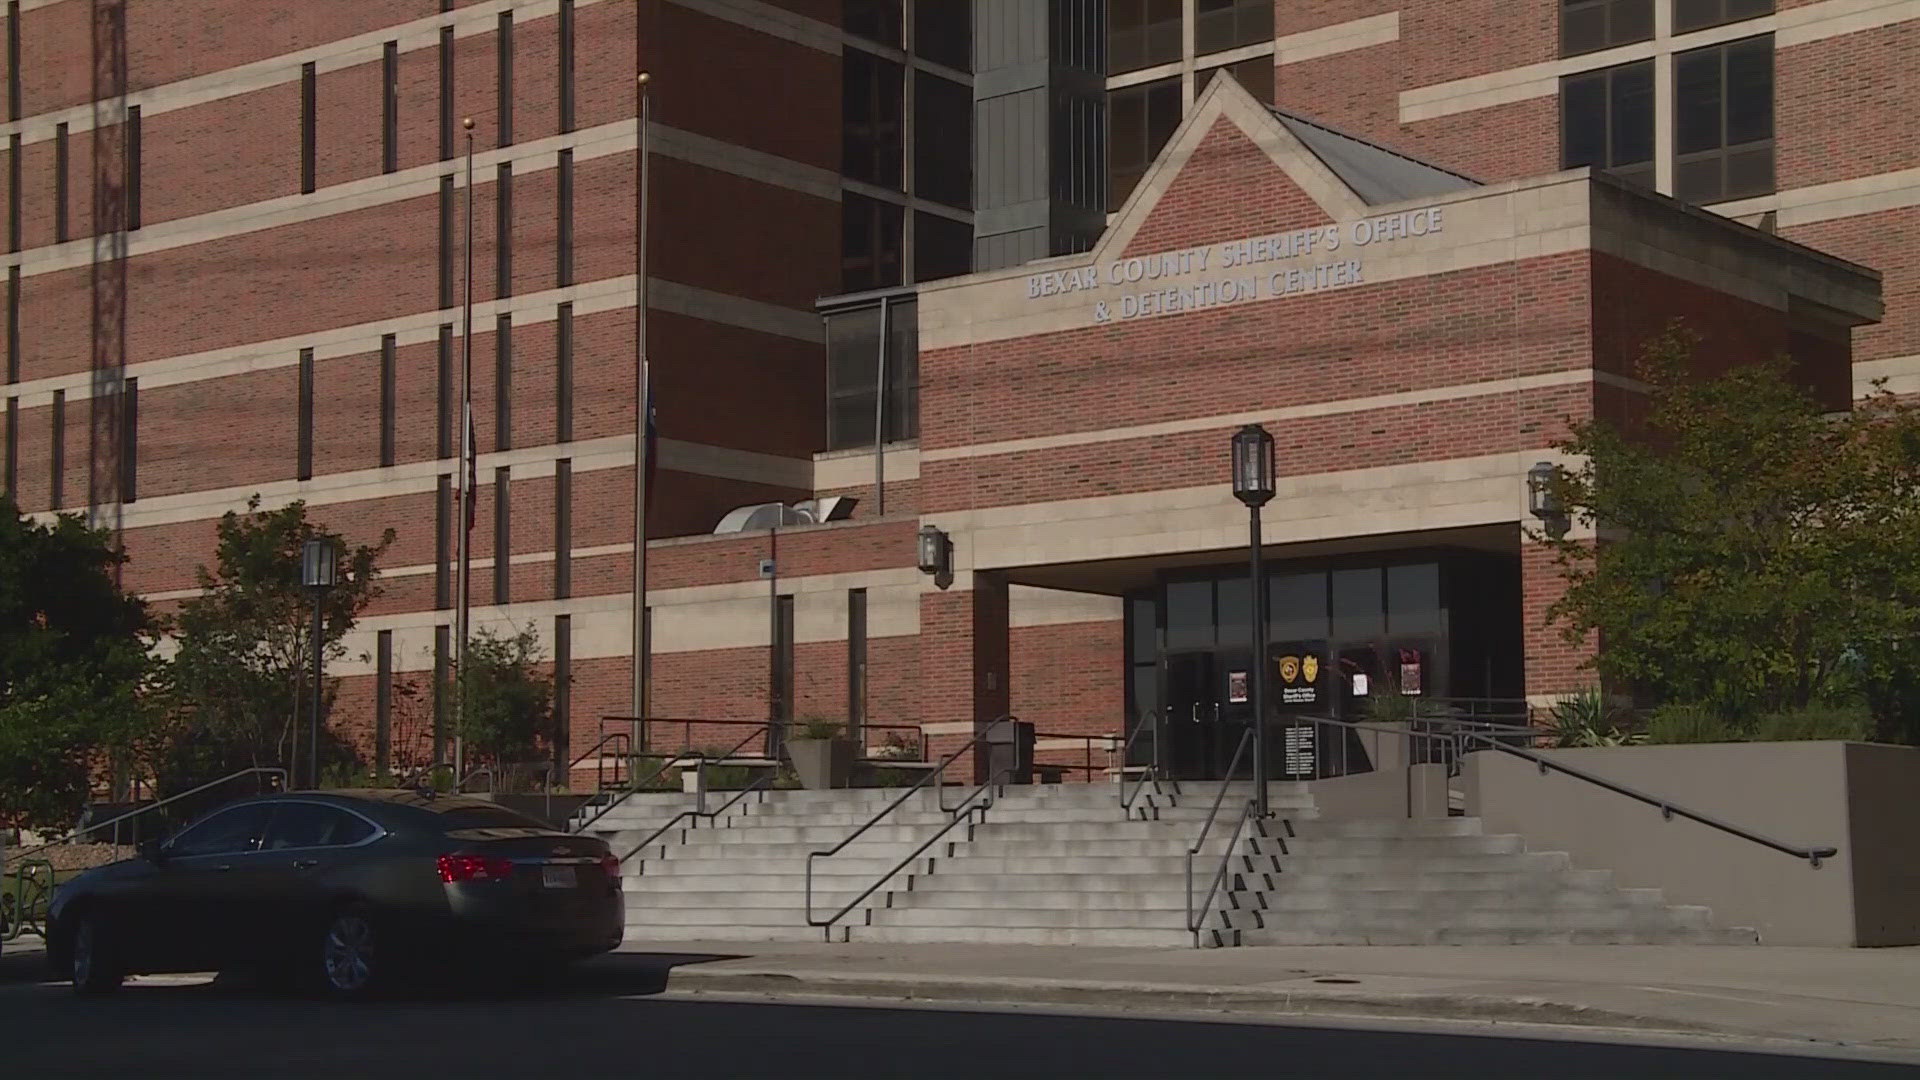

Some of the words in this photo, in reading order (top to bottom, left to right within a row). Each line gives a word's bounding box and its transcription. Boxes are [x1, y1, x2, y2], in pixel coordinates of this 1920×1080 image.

[1028, 268, 1098, 299] BEXAR
[1109, 247, 1211, 286] COUNTY
[1222, 226, 1341, 269] SHERIFF'S
[1351, 207, 1443, 247] OFFICE
[1095, 299, 1112, 323] &
[1121, 276, 1257, 319] DETENTION
[1270, 260, 1364, 297] CENTER
